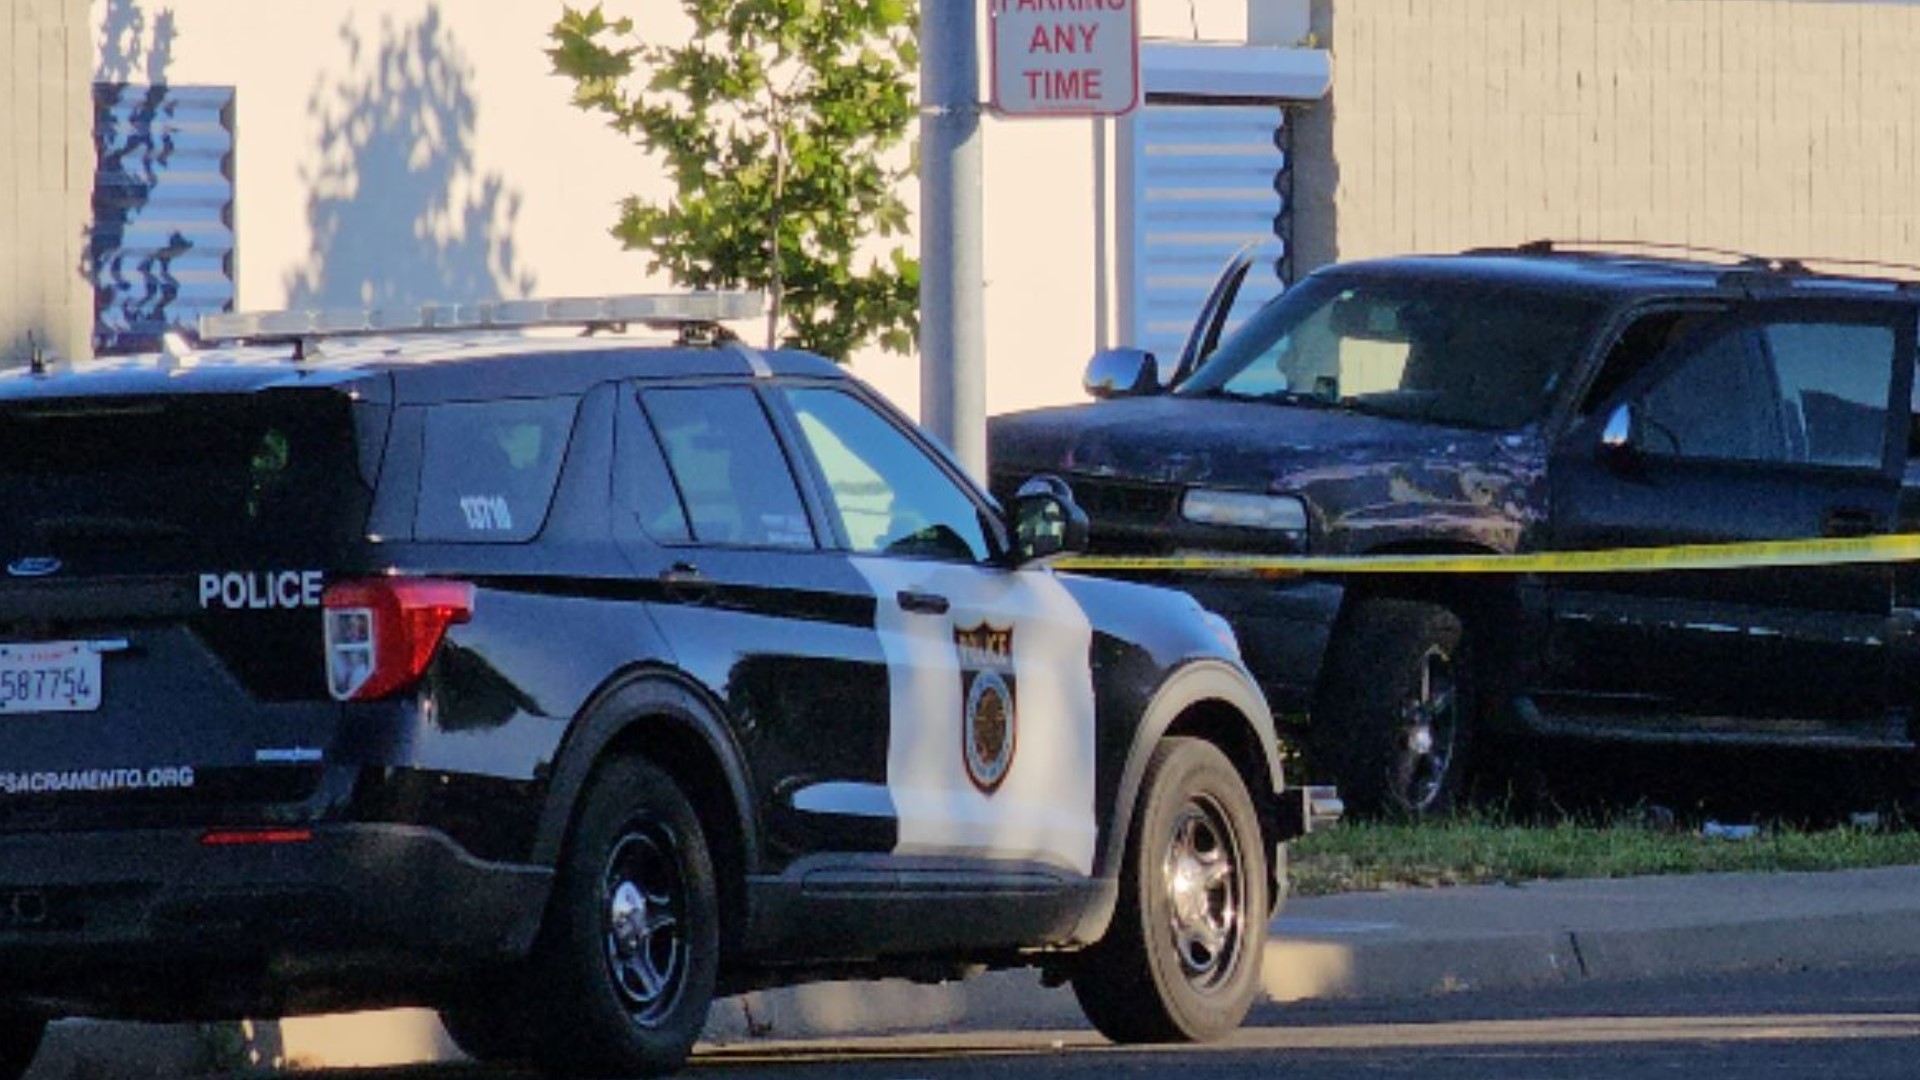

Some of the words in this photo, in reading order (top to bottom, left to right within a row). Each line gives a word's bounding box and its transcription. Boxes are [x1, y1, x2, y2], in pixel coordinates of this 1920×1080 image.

[1028, 22, 1099, 54] ANY
[1022, 69, 1102, 100] TIME
[199, 570, 324, 609] POLICE
[0, 665, 91, 701] 587754
